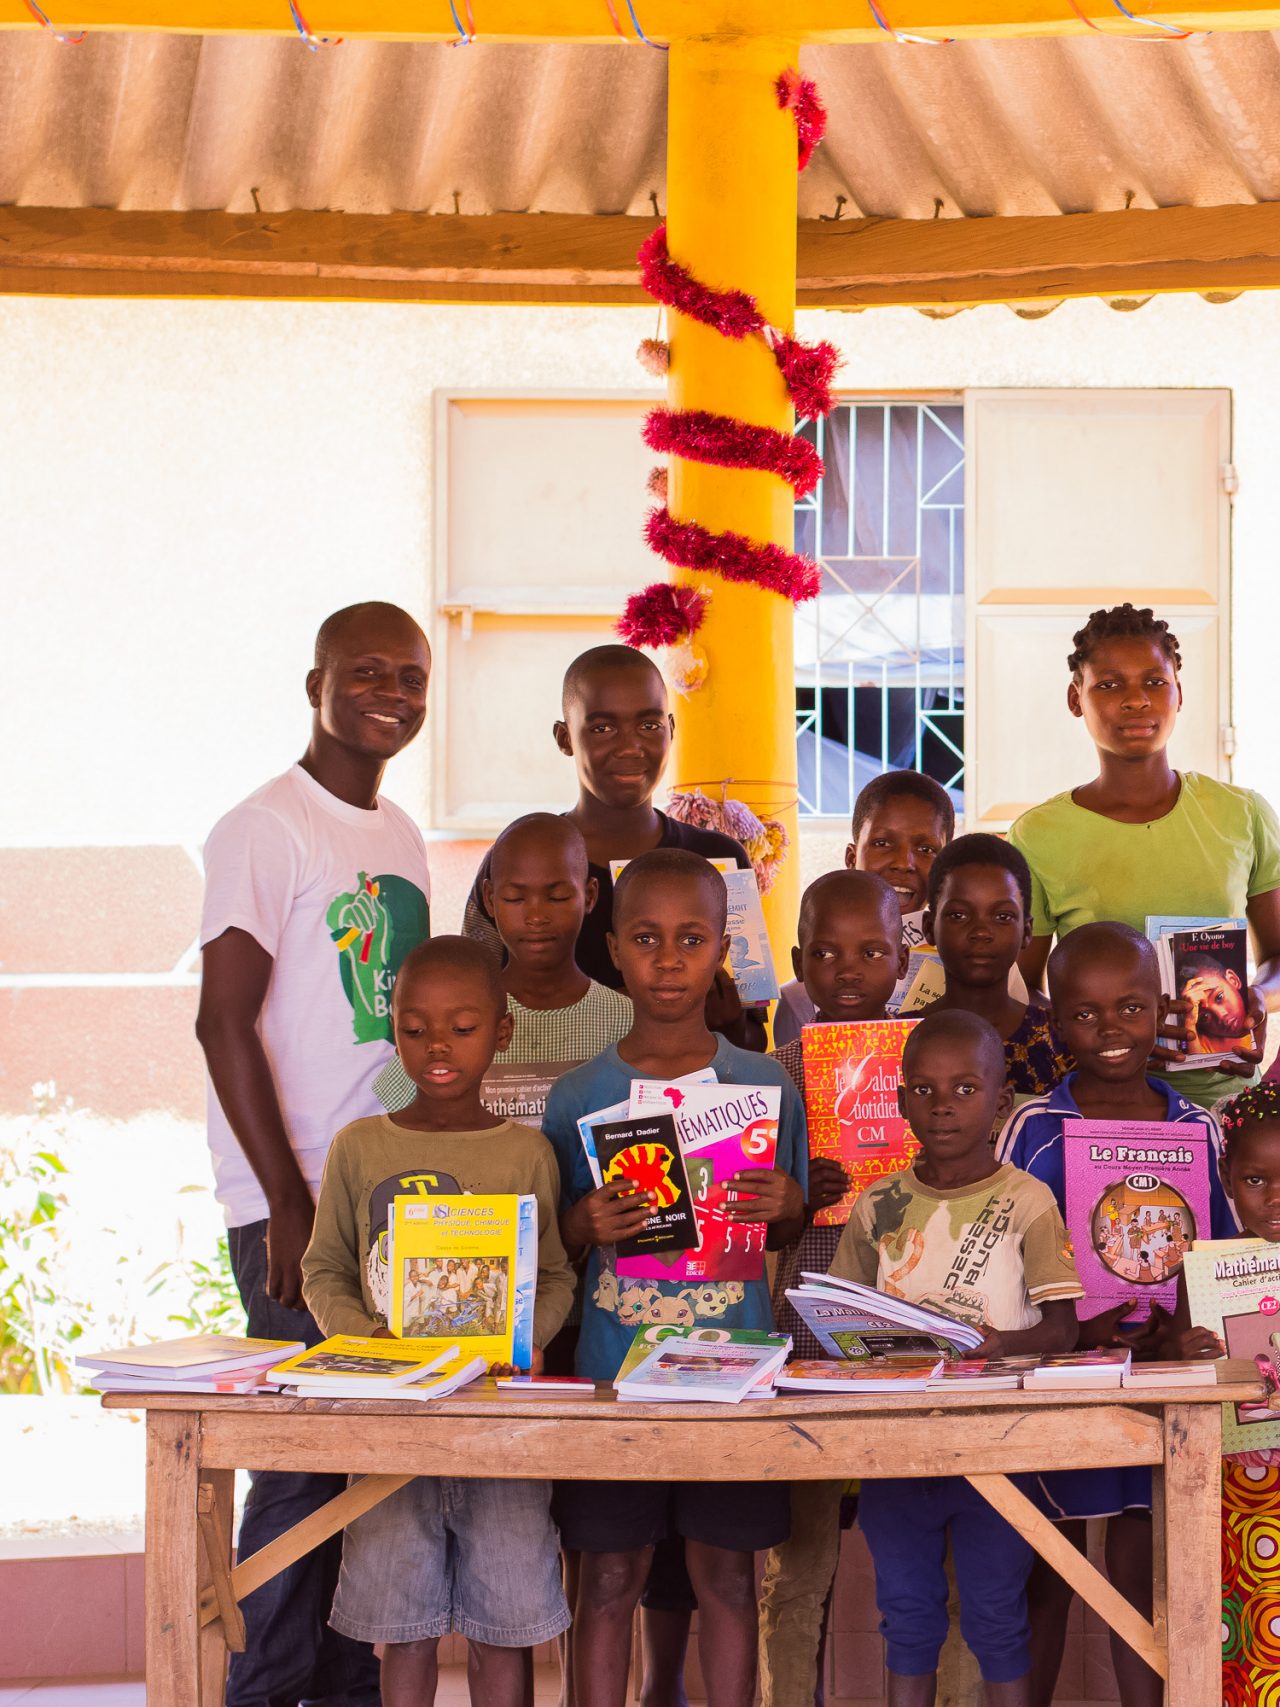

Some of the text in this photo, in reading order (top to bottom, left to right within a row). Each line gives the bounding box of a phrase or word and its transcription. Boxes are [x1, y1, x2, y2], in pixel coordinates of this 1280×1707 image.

[1200, 932, 1225, 942] Oyono
[1221, 940, 1235, 949] boy
[605, 1127, 660, 1140] Bernard Dadier
[857, 1125, 886, 1142] CM
[1090, 1146, 1193, 1165] Le Français
[1132, 1176, 1153, 1188] CM1
[665, 1212, 687, 1222] NOIR
[1232, 1279, 1257, 1288] Cahier
